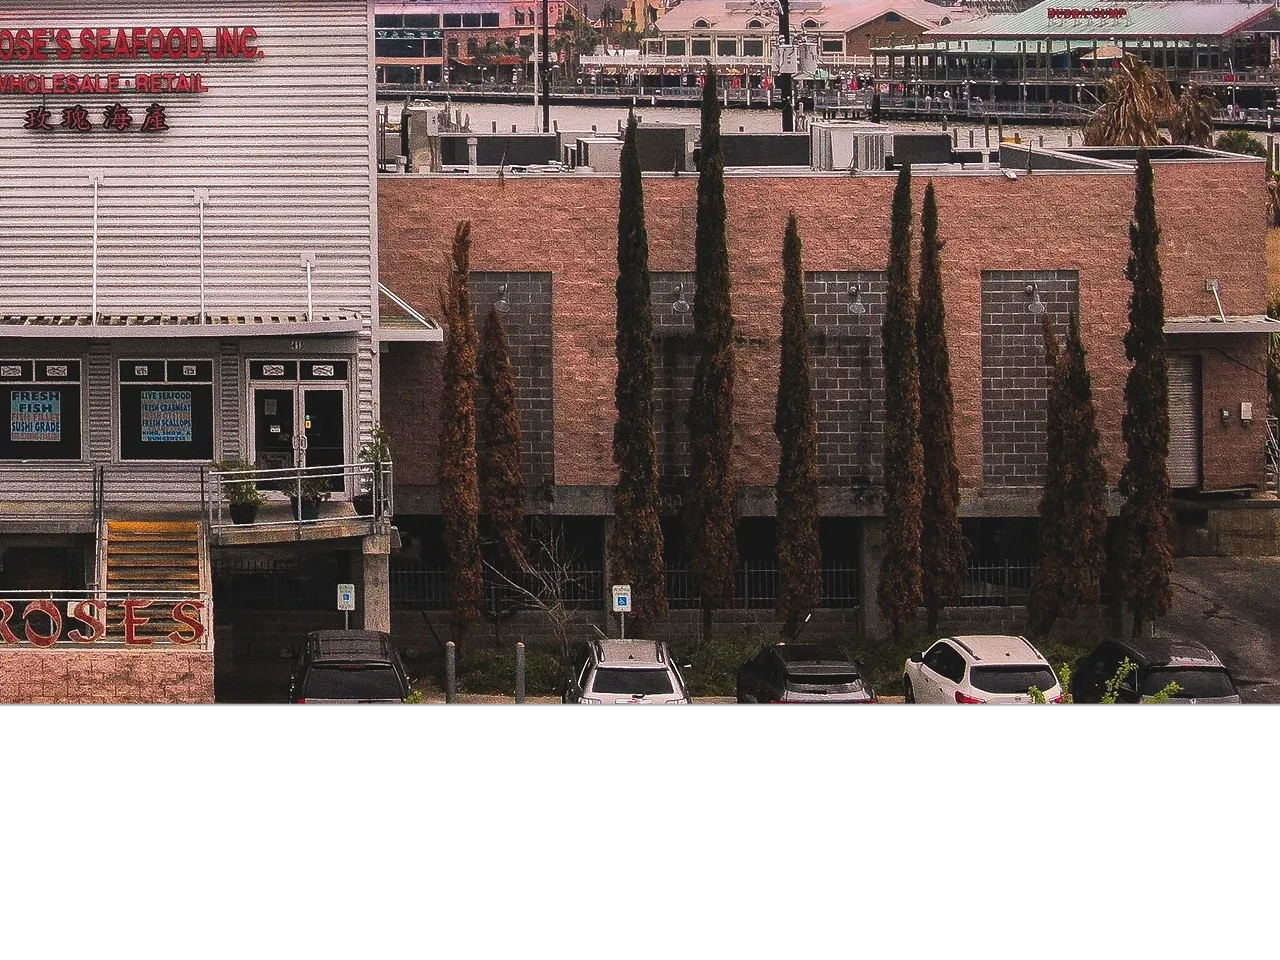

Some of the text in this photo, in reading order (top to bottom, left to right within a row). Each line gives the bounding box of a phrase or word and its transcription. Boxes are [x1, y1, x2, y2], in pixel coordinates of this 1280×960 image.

[78, 26, 210, 64] SEAFOOD,
[216, 26, 266, 60] INC.
[136, 73, 209, 93] RETAIL
[12, 392, 59, 401] FRESH
[141, 392, 191, 400] LIVE SEAFOOD
[19, 403, 53, 413] FISH
[11, 421, 60, 433] SUSHI GRADE
